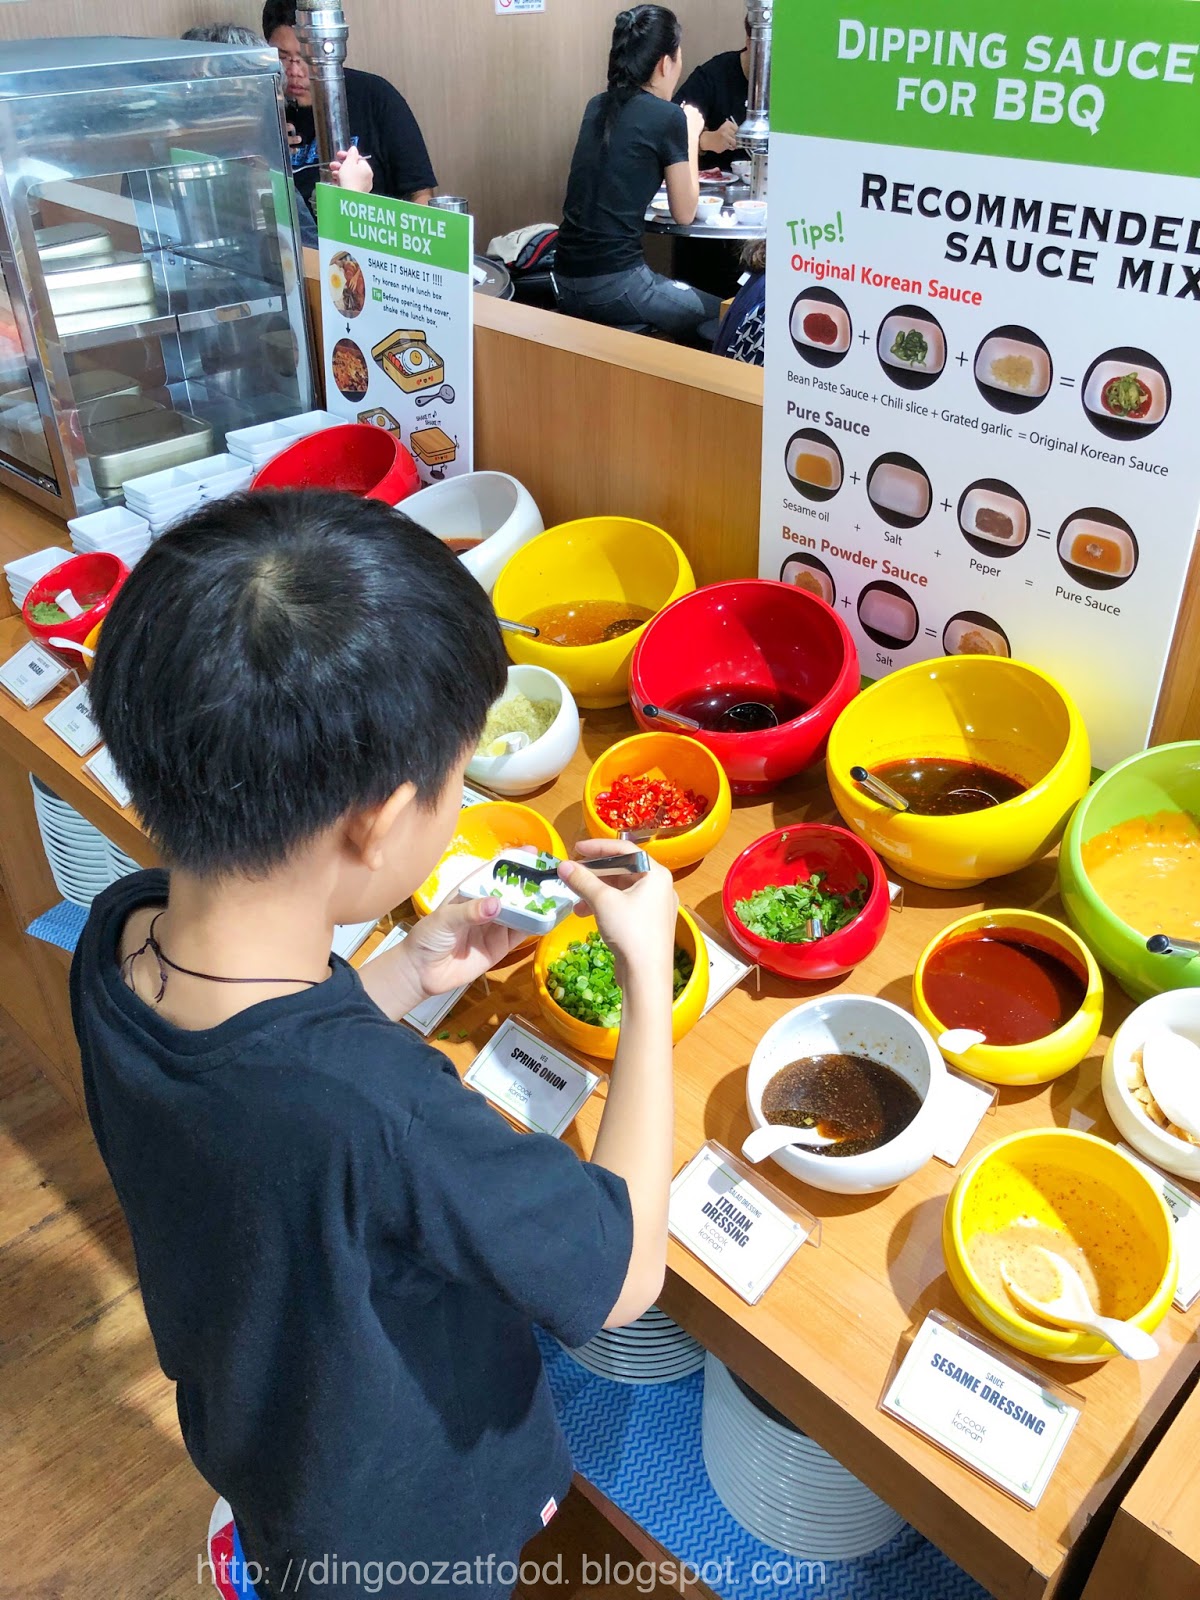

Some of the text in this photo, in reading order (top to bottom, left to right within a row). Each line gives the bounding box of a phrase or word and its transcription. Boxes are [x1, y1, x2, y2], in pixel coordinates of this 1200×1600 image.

[837, 19, 1200, 84] DIPPING SAUCE
[896, 78, 1106, 136] FOR BBQ
[340, 200, 446, 238] KOREAN STYLE
[786, 211, 846, 250] Tips!
[350, 221, 432, 256] LUNCH BOX
[368, 258, 388, 271] SHAKE
[390, 263, 397, 274] IT
[400, 266, 420, 280] SHAKE
[422, 272, 430, 282] IT
[944, 232, 1099, 284] SAUCE
[372, 275, 381, 285] Try
[401, 281, 415, 293] style
[416, 284, 431, 297] lunch
[432, 289, 442, 300] box
[790, 254, 983, 306] Original Korean Sauce
[383, 292, 400, 304] Before
[401, 297, 421, 311] opening
[423, 302, 433, 313] the
[383, 304, 398, 316] shake
[400, 308, 410, 319] the
[410, 309, 425, 323] lunch
[786, 400, 870, 437] Pure Sauce
[787, 370, 1169, 477] Bean Paste Sauce + Chili slice + Grated garlic = Original Korean Sauce
[782, 525, 928, 587] Bean Powder Sauce
[782, 498, 817, 518] Sesame
[818, 510, 830, 523] oil
[854, 523, 861, 531] +
[884, 531, 903, 546] Salt
[934, 549, 942, 557] +
[969, 558, 1001, 578] Peper
[1055, 585, 1082, 603] Pure
[1085, 595, 1121, 616] Sauce
[28, 661, 45, 676] WASABI
[875, 652, 893, 667] Salt
[510, 1047, 567, 1091] SPRING ONION
[540, 1053, 549, 1063] VEG
[508, 1087, 529, 1104] korean
[715, 1196, 754, 1232] ITALIAN
[728, 1187, 762, 1219] SALAD DRESSING
[698, 1228, 723, 1253] korean
[701, 1201, 750, 1248] DRESSING
[930, 1353, 1046, 1436] SESAME DRESSING
[985, 1372, 1005, 1389] SAUCE
[951, 1418, 983, 1443] korean
